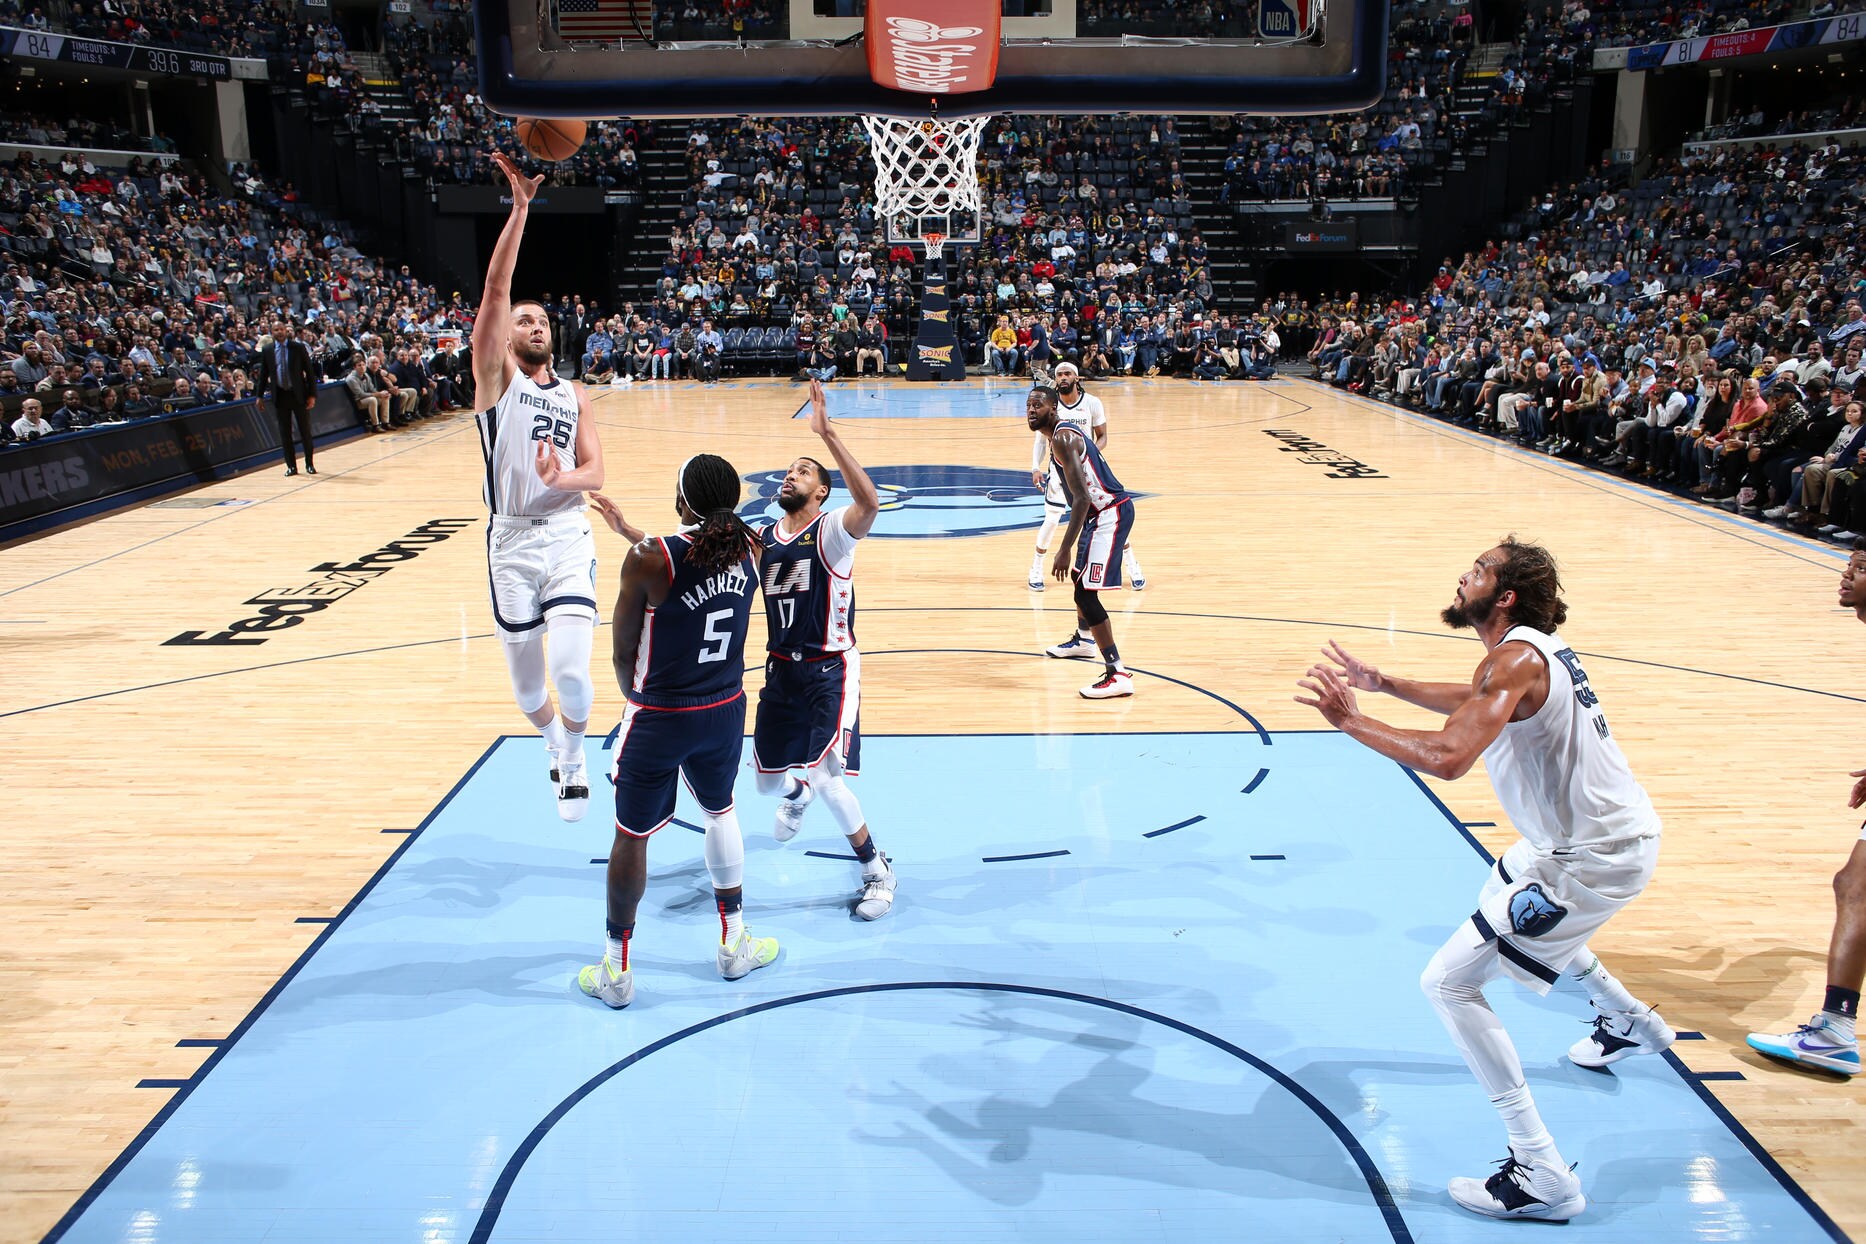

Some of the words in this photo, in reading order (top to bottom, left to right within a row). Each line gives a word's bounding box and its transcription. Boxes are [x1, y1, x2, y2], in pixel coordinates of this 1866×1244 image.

[1265, 11, 1290, 31] NBA
[1837, 17, 1860, 41] 84
[27, 34, 51, 57] 84
[71, 40, 111, 56] TIMEOUTS:
[111, 47, 116, 56] 4
[1713, 34, 1749, 46] TIMEOUTS:
[1750, 33, 1755, 41] 4
[72, 53, 99, 65] FOULS:
[99, 56, 103, 64] 5
[148, 50, 180, 74] 39.6
[190, 59, 208, 73] 3RD
[209, 61, 226, 75] QTR
[1678, 42, 1693, 62] 81
[1711, 48, 1735, 58] FOULS:
[1736, 47, 1741, 56] 5
[920, 349, 950, 357] SONIC
[531, 414, 573, 449] 25
[102, 450, 148, 473] MON,
[149, 442, 182, 461] FEB.
[189, 432, 207, 450] 25
[159, 518, 479, 645] FedExForum
[765, 559, 812, 596] LA
[777, 598, 795, 629] 17
[697, 607, 734, 664] 5
